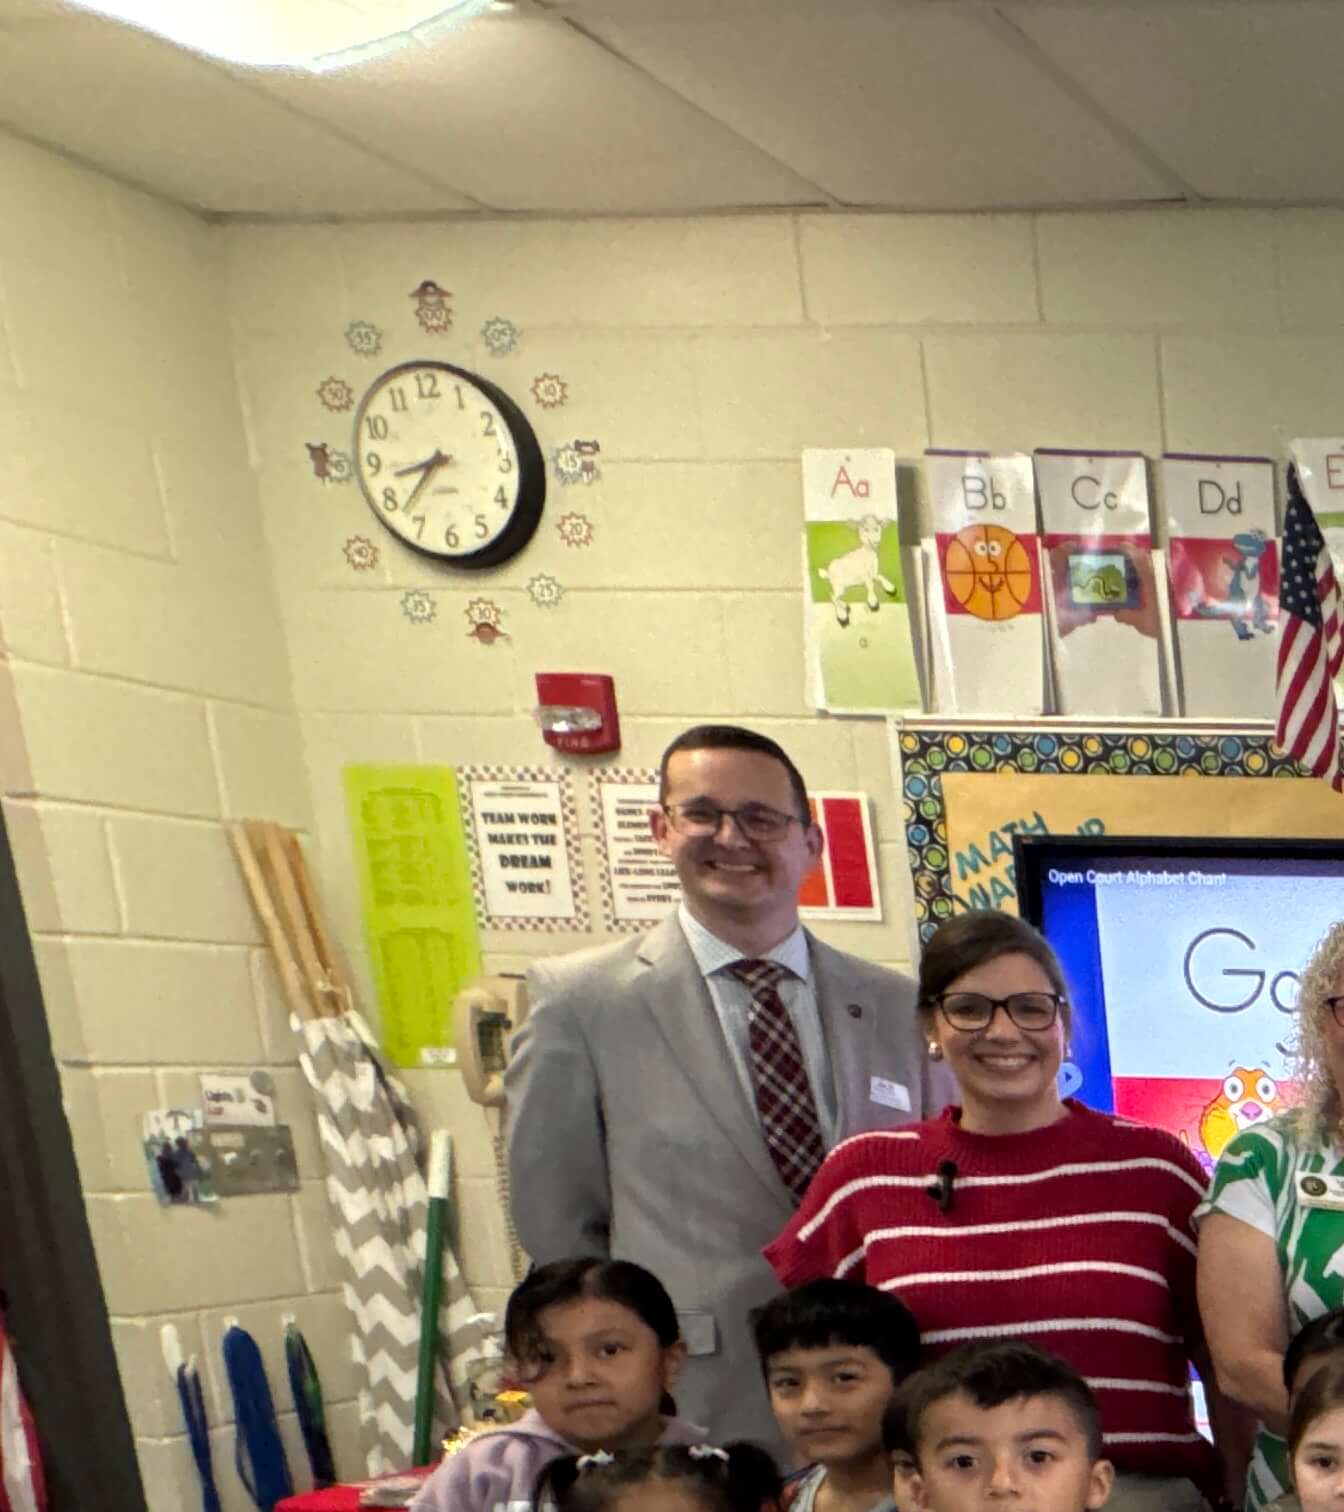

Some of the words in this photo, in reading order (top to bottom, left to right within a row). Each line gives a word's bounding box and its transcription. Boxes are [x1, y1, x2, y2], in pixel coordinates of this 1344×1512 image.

[415, 374, 441, 399] 12
[455, 385, 465, 409] 1
[389, 387, 408, 412] 11
[365, 415, 388, 441] 10
[480, 411, 496, 437] 2
[366, 453, 381, 476] 9
[831, 466, 870, 499] Aa
[962, 475, 1007, 511] Bb
[1071, 476, 1118, 511] Cc
[382, 488, 398, 512] 8
[494, 486, 508, 509] 4
[1199, 480, 1244, 515] Dd
[412, 516, 426, 539] 7
[445, 524, 460, 547] 6
[474, 515, 489, 538] 5
[482, 812, 516, 825] TEAM
[518, 813, 557, 826] WORK
[488, 832, 530, 846] MAKES
[530, 833, 557, 846] THE
[499, 854, 553, 870] DREAM
[505, 879, 552, 896] WORK!
[1048, 869, 1084, 886] Open
[1086, 870, 1123, 885] Court
[1126, 870, 1185, 886] Alphabet
[1187, 870, 1228, 886] Chant
